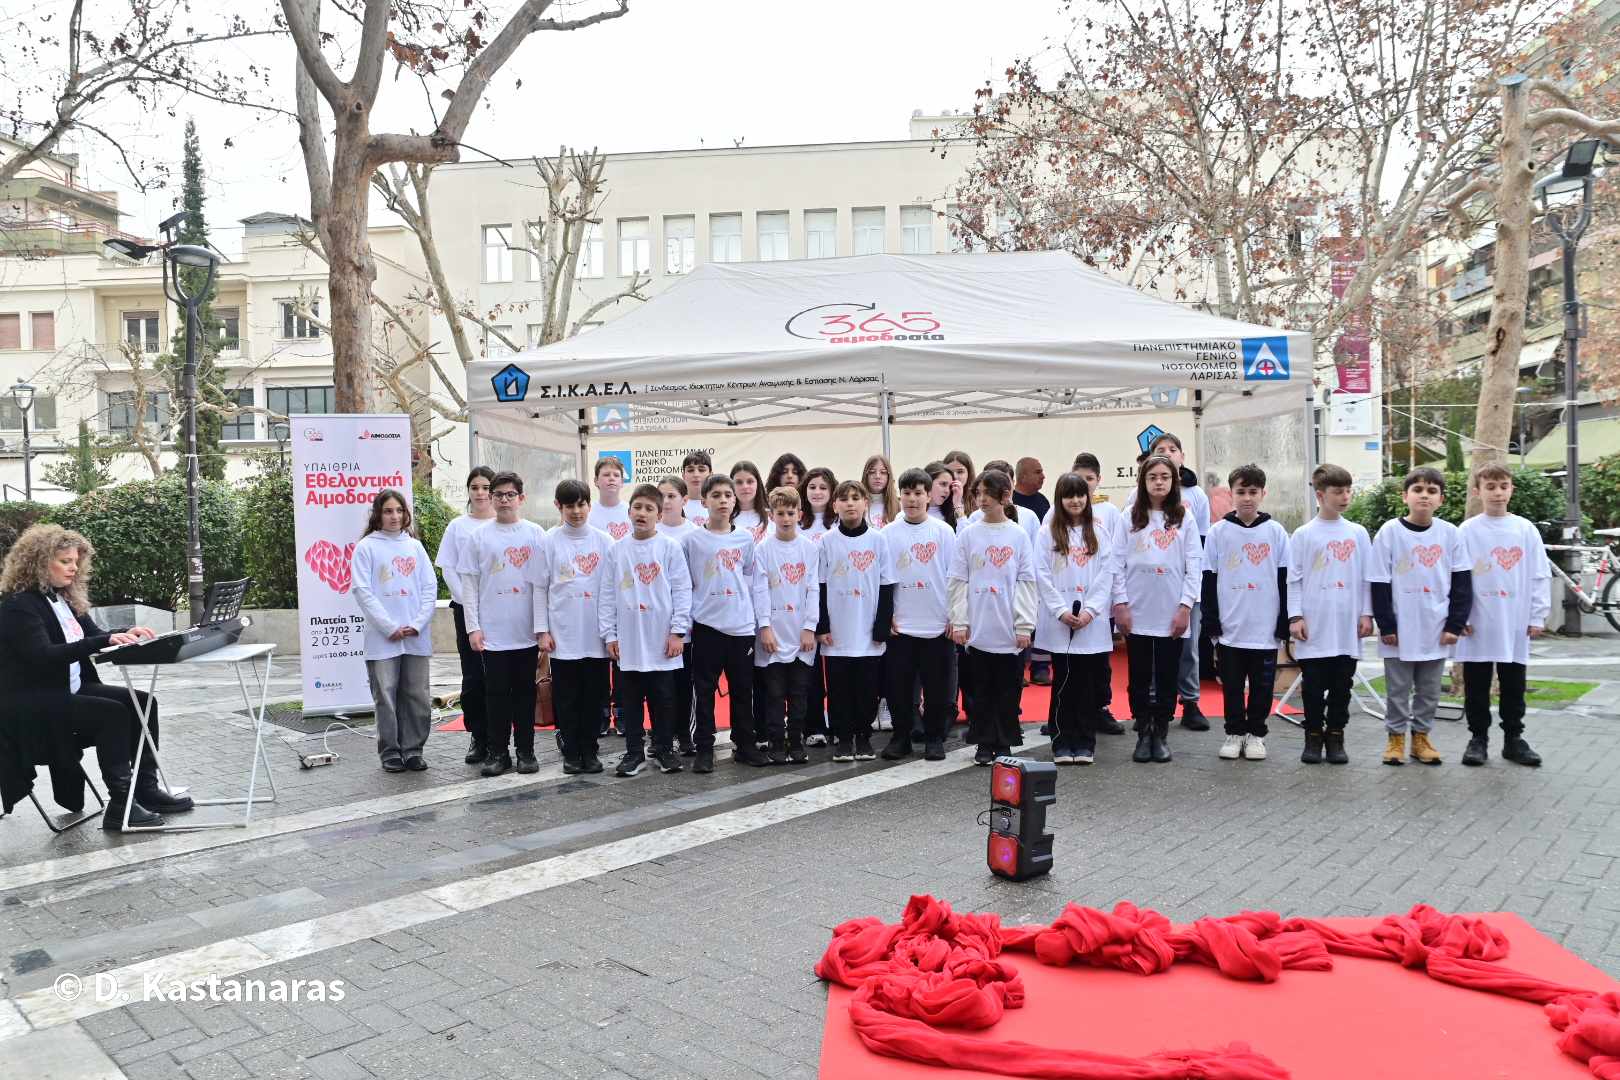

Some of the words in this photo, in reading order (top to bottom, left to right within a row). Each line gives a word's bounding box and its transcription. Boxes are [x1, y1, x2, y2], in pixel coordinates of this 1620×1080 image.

[818, 311, 941, 336] 365
[830, 331, 945, 344] αιμοδοσία
[1133, 341, 1236, 352] ΠΑΝΕΠΙΣΤΗΜΙΑΚΟ
[1196, 352, 1237, 361] ΓΕΝΙΚΟ
[1162, 361, 1237, 371] ΝΟΣΟΚΟΜΕΙΟ
[1190, 371, 1238, 381] ΛΑΡΙΣΑΣ
[540, 381, 637, 399] Σ.Ι.Κ.Α.Ε.Λ.
[304, 462, 361, 472] ΥΠΑΙΘΡΙΑ
[635, 458, 667, 467] ΓΕΝΙΚΟ
[305, 470, 404, 488] Εθελοντική
[635, 475, 660, 483] ΛΑΡΙΣ
[305, 487, 380, 509] Αιμοδοσ
[310, 614, 347, 626] Πλατεία
[324, 625, 350, 635] 17/02
[311, 634, 350, 647] 2025
[329, 650, 364, 659] 10.00-14.0
